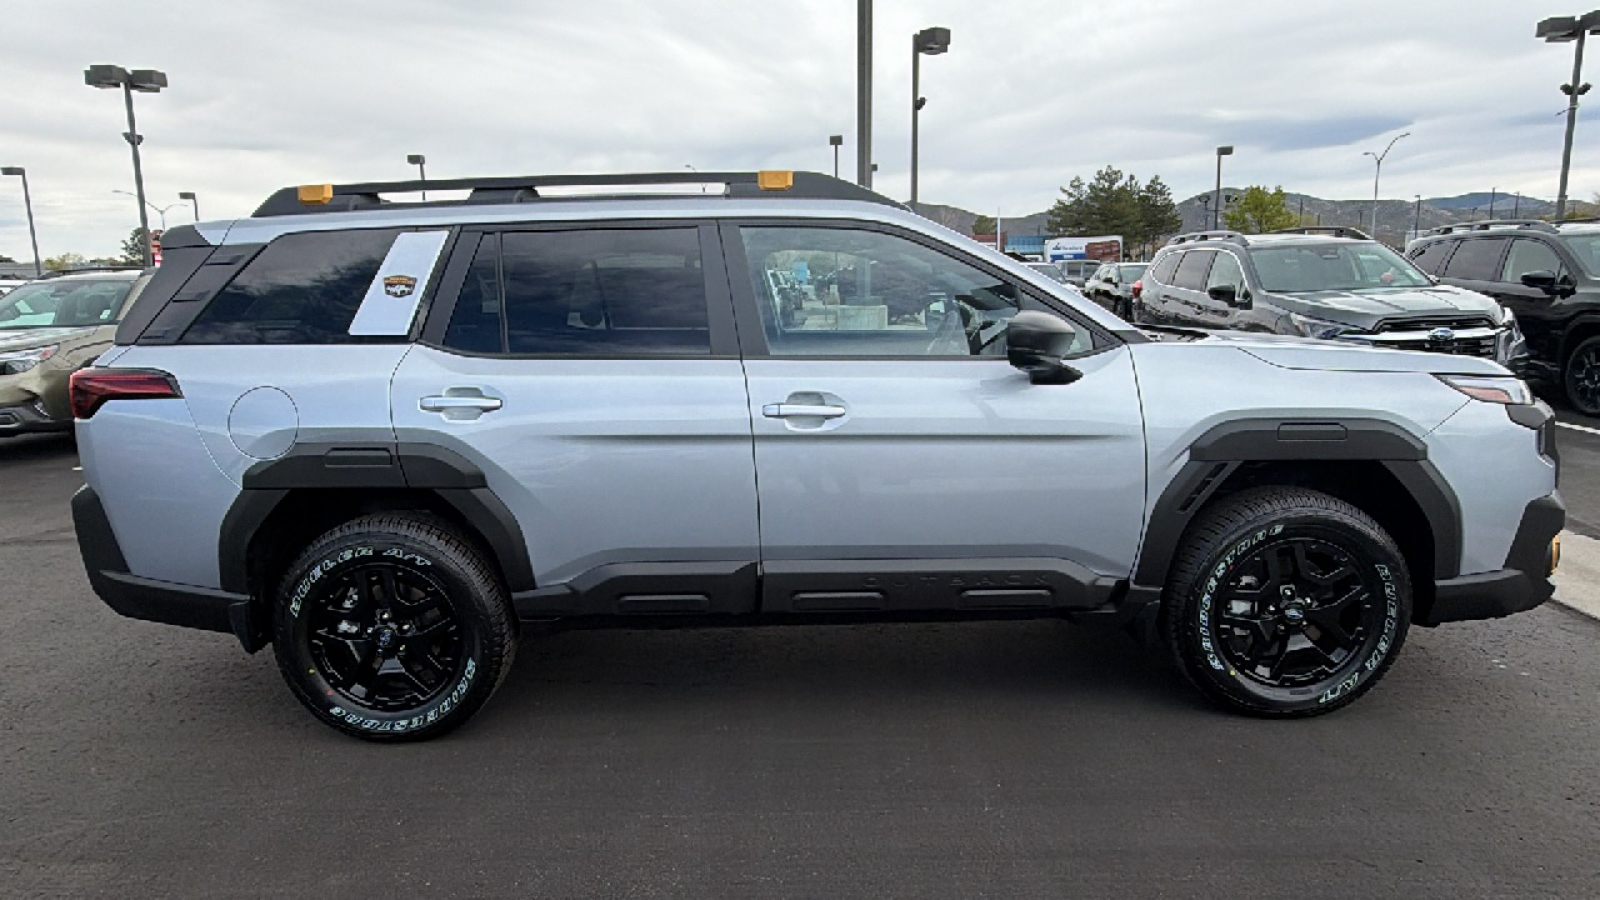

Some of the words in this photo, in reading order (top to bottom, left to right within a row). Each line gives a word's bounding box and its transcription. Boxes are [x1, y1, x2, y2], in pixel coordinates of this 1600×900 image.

[862, 574, 1049, 587] OUTBACK
[1199, 524, 1285, 671] BRIDGESTONE
[1364, 563, 1397, 672] DUELER
[329, 657, 477, 732] BRIDGESTONE
